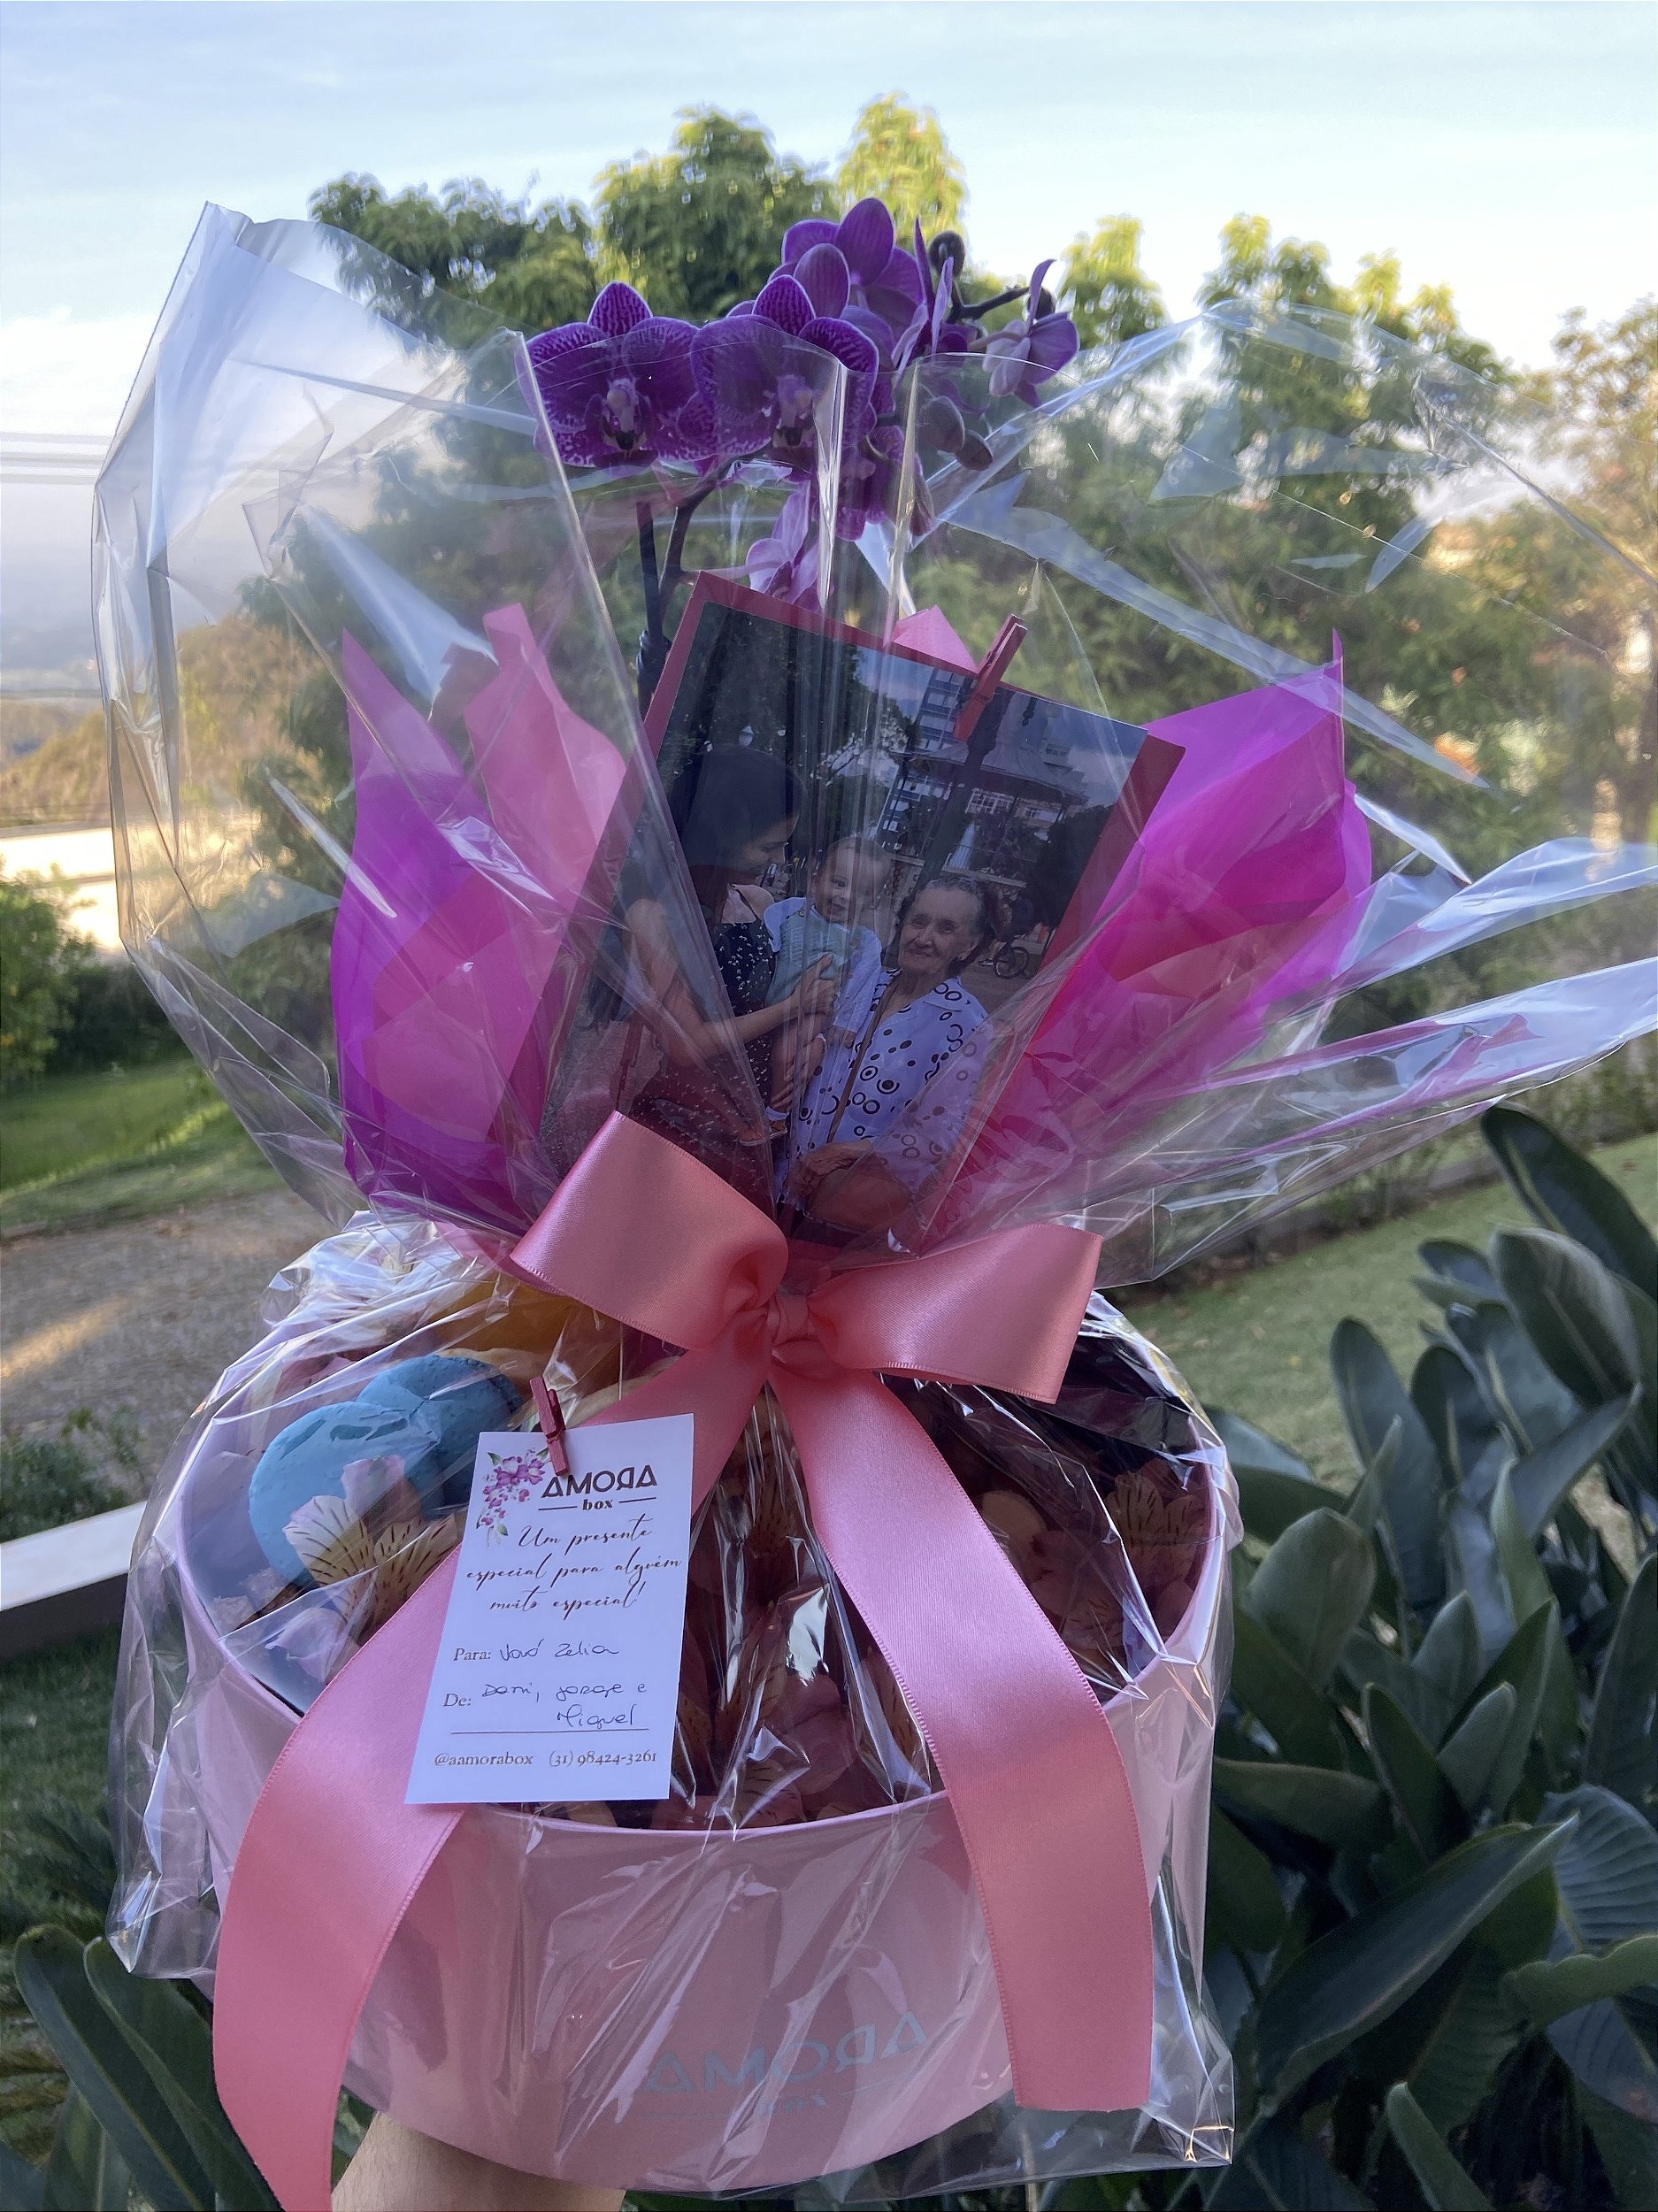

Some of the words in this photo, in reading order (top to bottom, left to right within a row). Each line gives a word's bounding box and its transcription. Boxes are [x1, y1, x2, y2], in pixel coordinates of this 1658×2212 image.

[581, 1498, 614, 1511] box
[518, 1525, 561, 1548] Um
[564, 1513, 654, 1556] presente
[466, 1553, 553, 1592] especial
[549, 1566, 604, 1589] para
[614, 1546, 683, 1589] alguém
[490, 1585, 549, 1612] muito
[453, 1647, 492, 1662] Para:
[443, 1693, 472, 1707] De:
[637, 1683, 649, 1694] e
[434, 1751, 534, 1766] @aamorabox
[549, 1749, 575, 1767] (31)
[577, 1748, 658, 1766] 98424-3261
